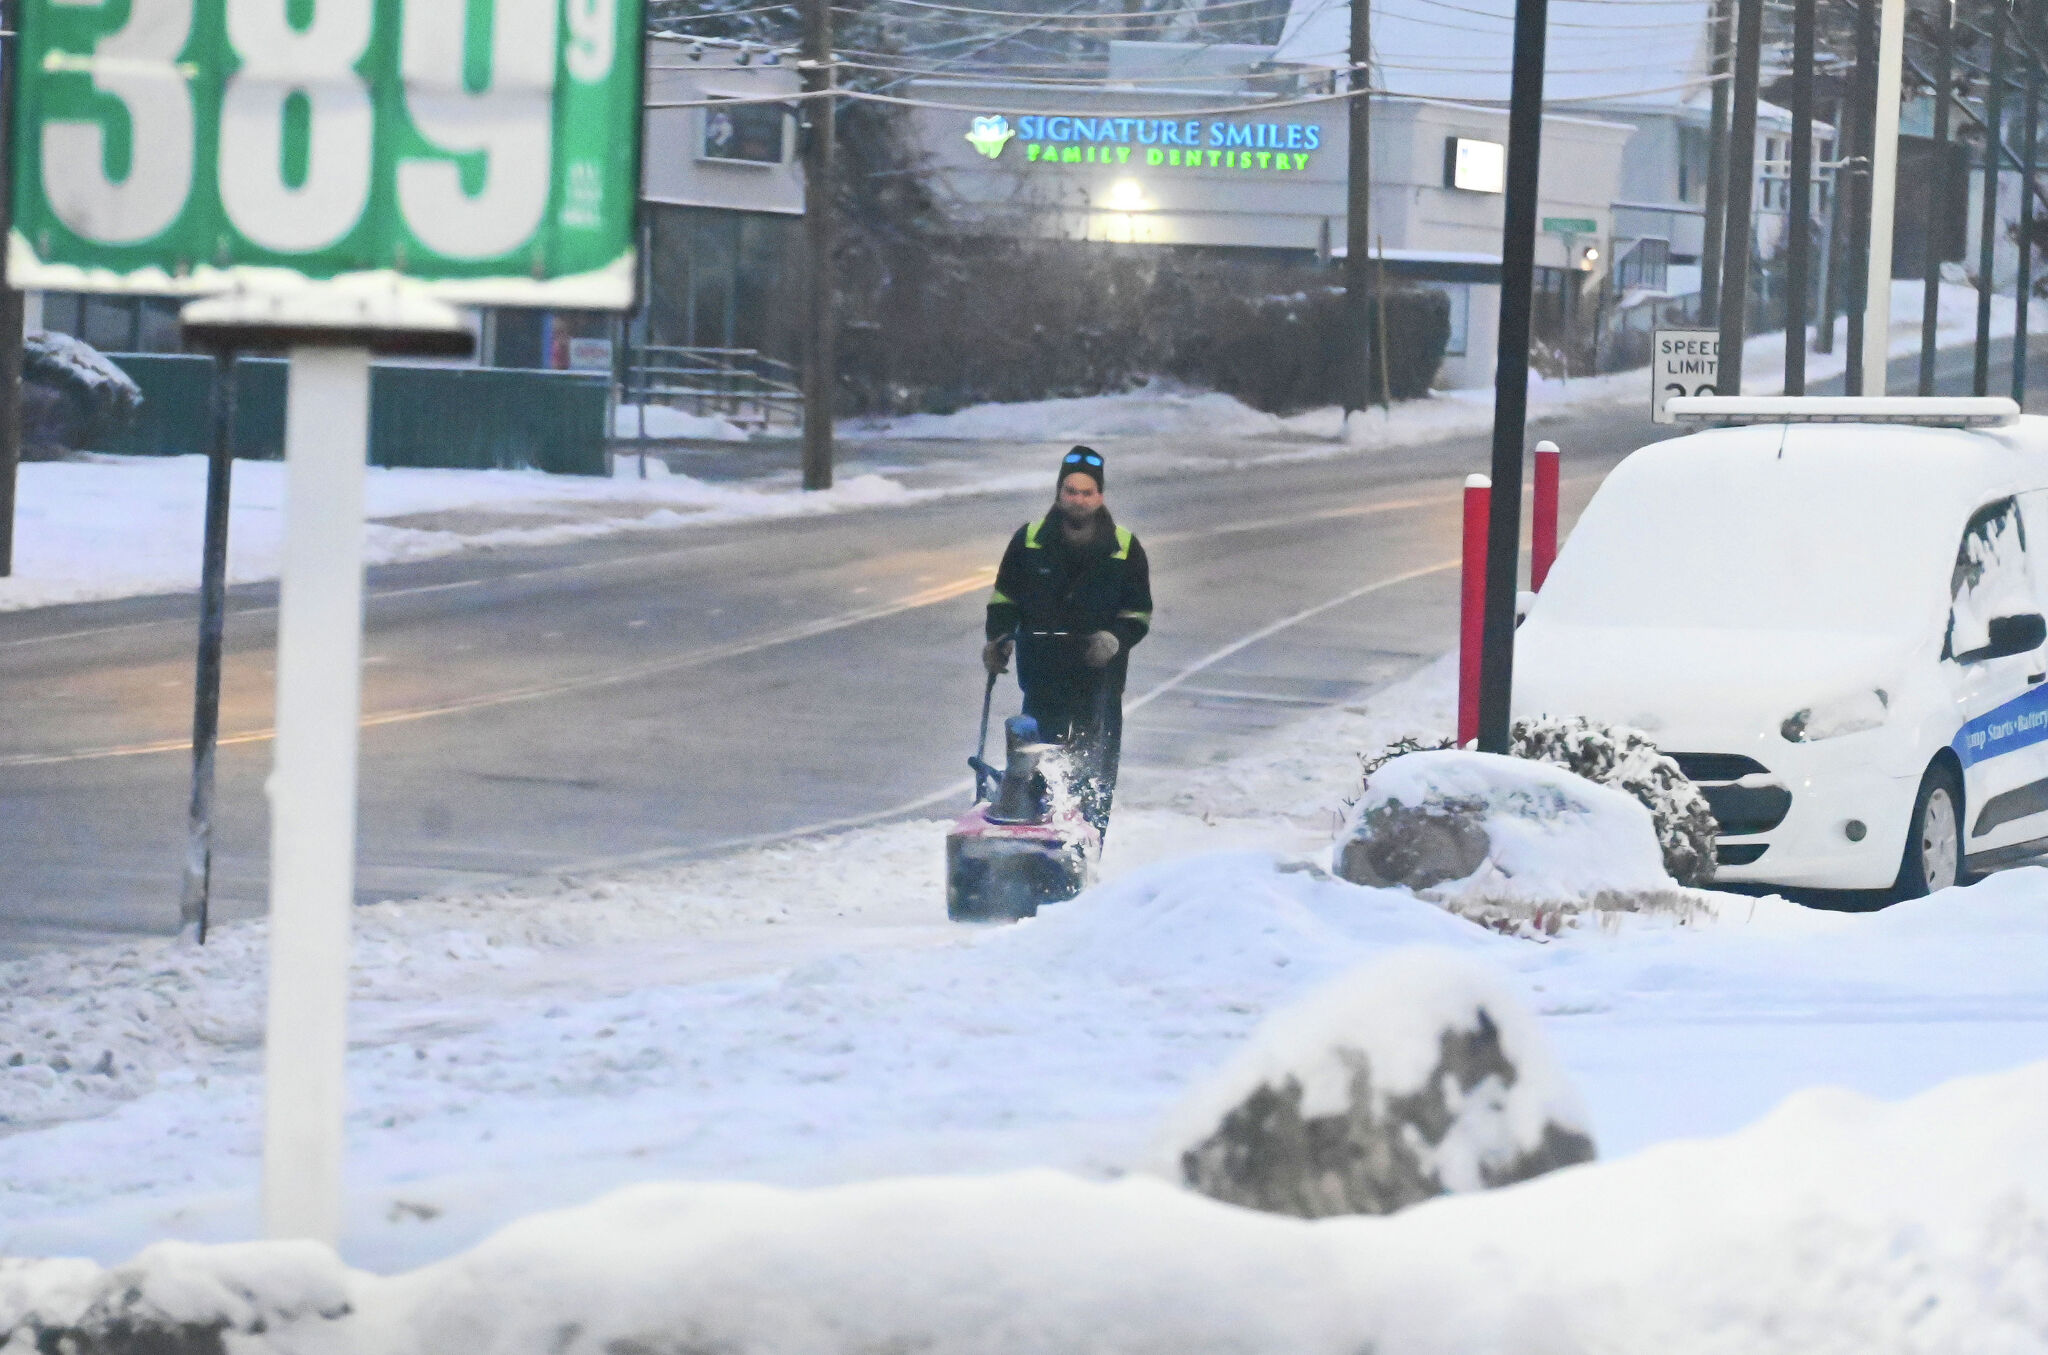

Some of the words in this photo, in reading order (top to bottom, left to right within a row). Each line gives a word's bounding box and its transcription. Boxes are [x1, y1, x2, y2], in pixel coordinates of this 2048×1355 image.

[40, 0, 560, 261] 389
[1018, 116, 1200, 145] SIGNATURE
[1209, 121, 1321, 150] SMILES
[1028, 143, 1131, 164] FAMILY
[1146, 147, 1309, 171] DENTISTRY
[1667, 360, 1716, 375] LIMIT
